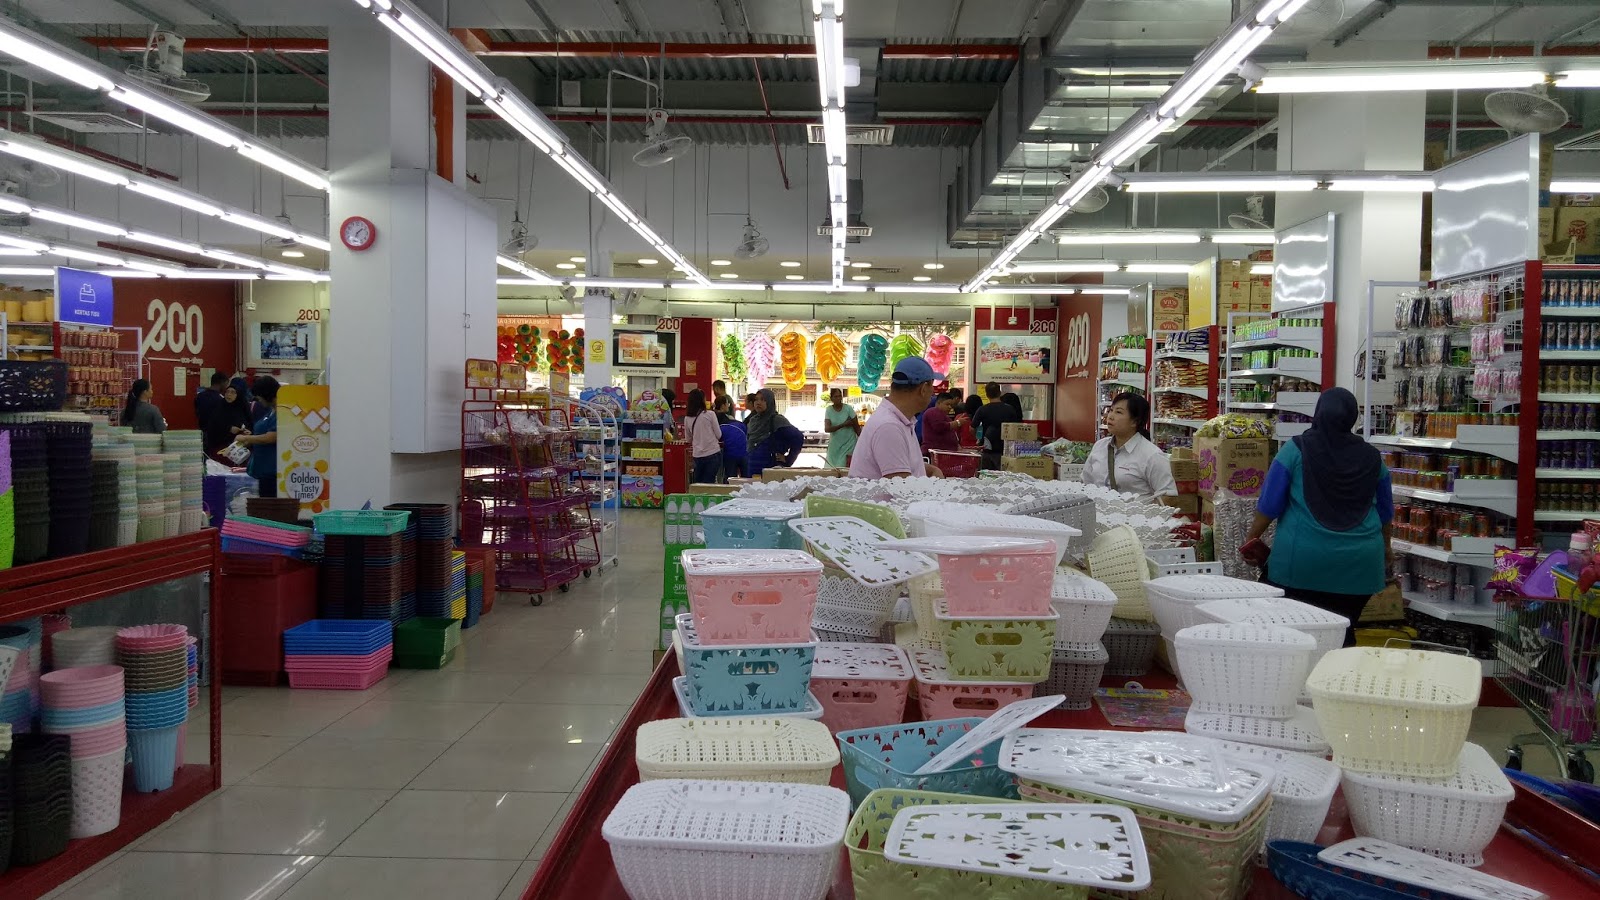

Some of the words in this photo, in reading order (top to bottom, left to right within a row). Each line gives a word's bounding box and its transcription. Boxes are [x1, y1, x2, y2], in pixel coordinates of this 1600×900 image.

[291, 472, 320, 483] Golden
[301, 483, 319, 494] Tasty
[294, 490, 314, 499] Times
